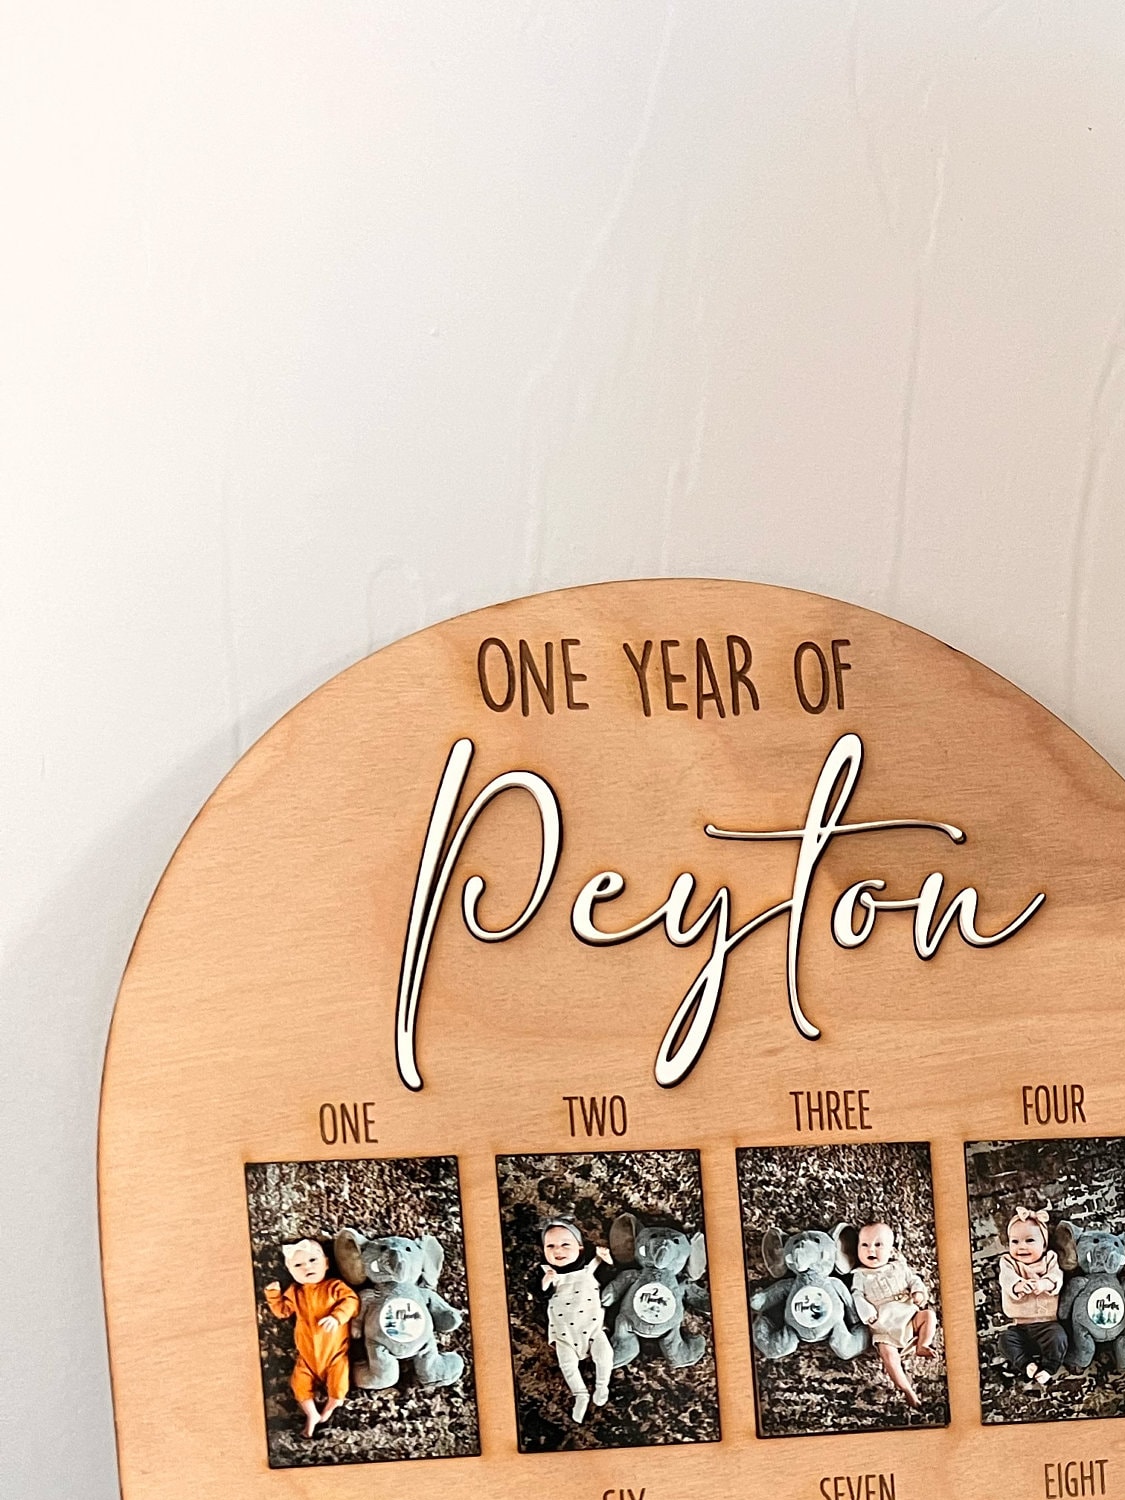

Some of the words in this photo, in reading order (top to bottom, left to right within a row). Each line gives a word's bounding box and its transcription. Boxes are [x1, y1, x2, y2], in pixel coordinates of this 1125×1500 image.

[477, 637, 590, 718] ONE
[622, 634, 760, 720] YEAR
[793, 638, 852, 715] OF
[394, 731, 1047, 1092] Peyton
[318, 1101, 379, 1146] ONE
[562, 1094, 628, 1138] TWO
[788, 1089, 873, 1132] THREE
[1021, 1084, 1087, 1126] FOUR
[1044, 1459, 1109, 1500] EIGHT
